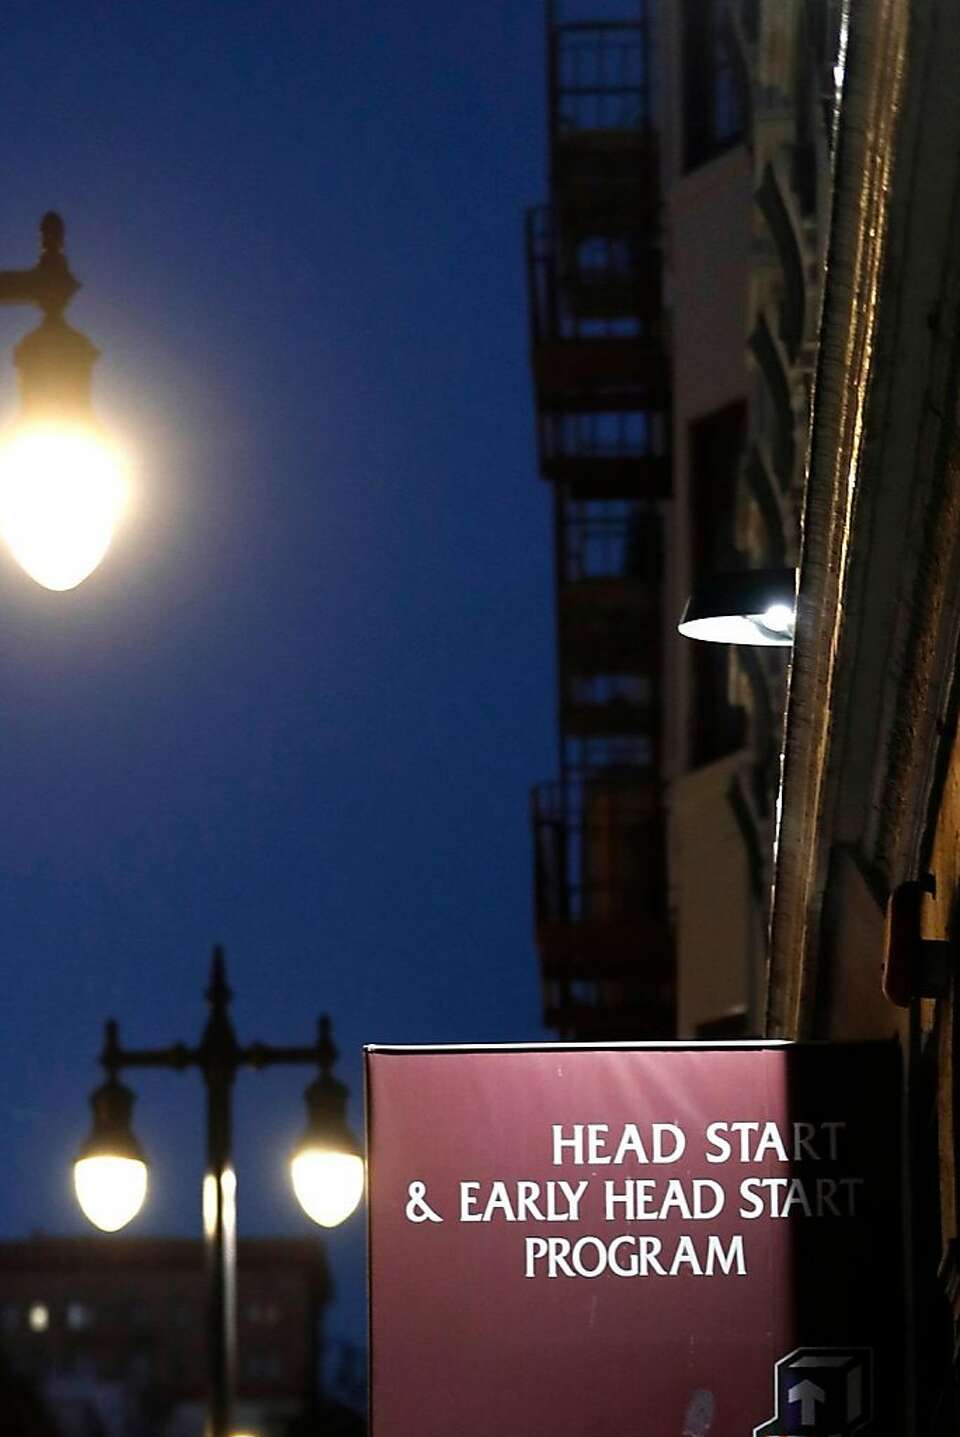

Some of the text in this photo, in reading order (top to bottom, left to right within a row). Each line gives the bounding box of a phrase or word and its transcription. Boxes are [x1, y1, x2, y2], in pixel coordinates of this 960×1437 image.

[551, 1120, 848, 1165] HEAD START
[405, 1176, 865, 1222] & EARLY HEAD START
[524, 1234, 748, 1278] PROGRAM
